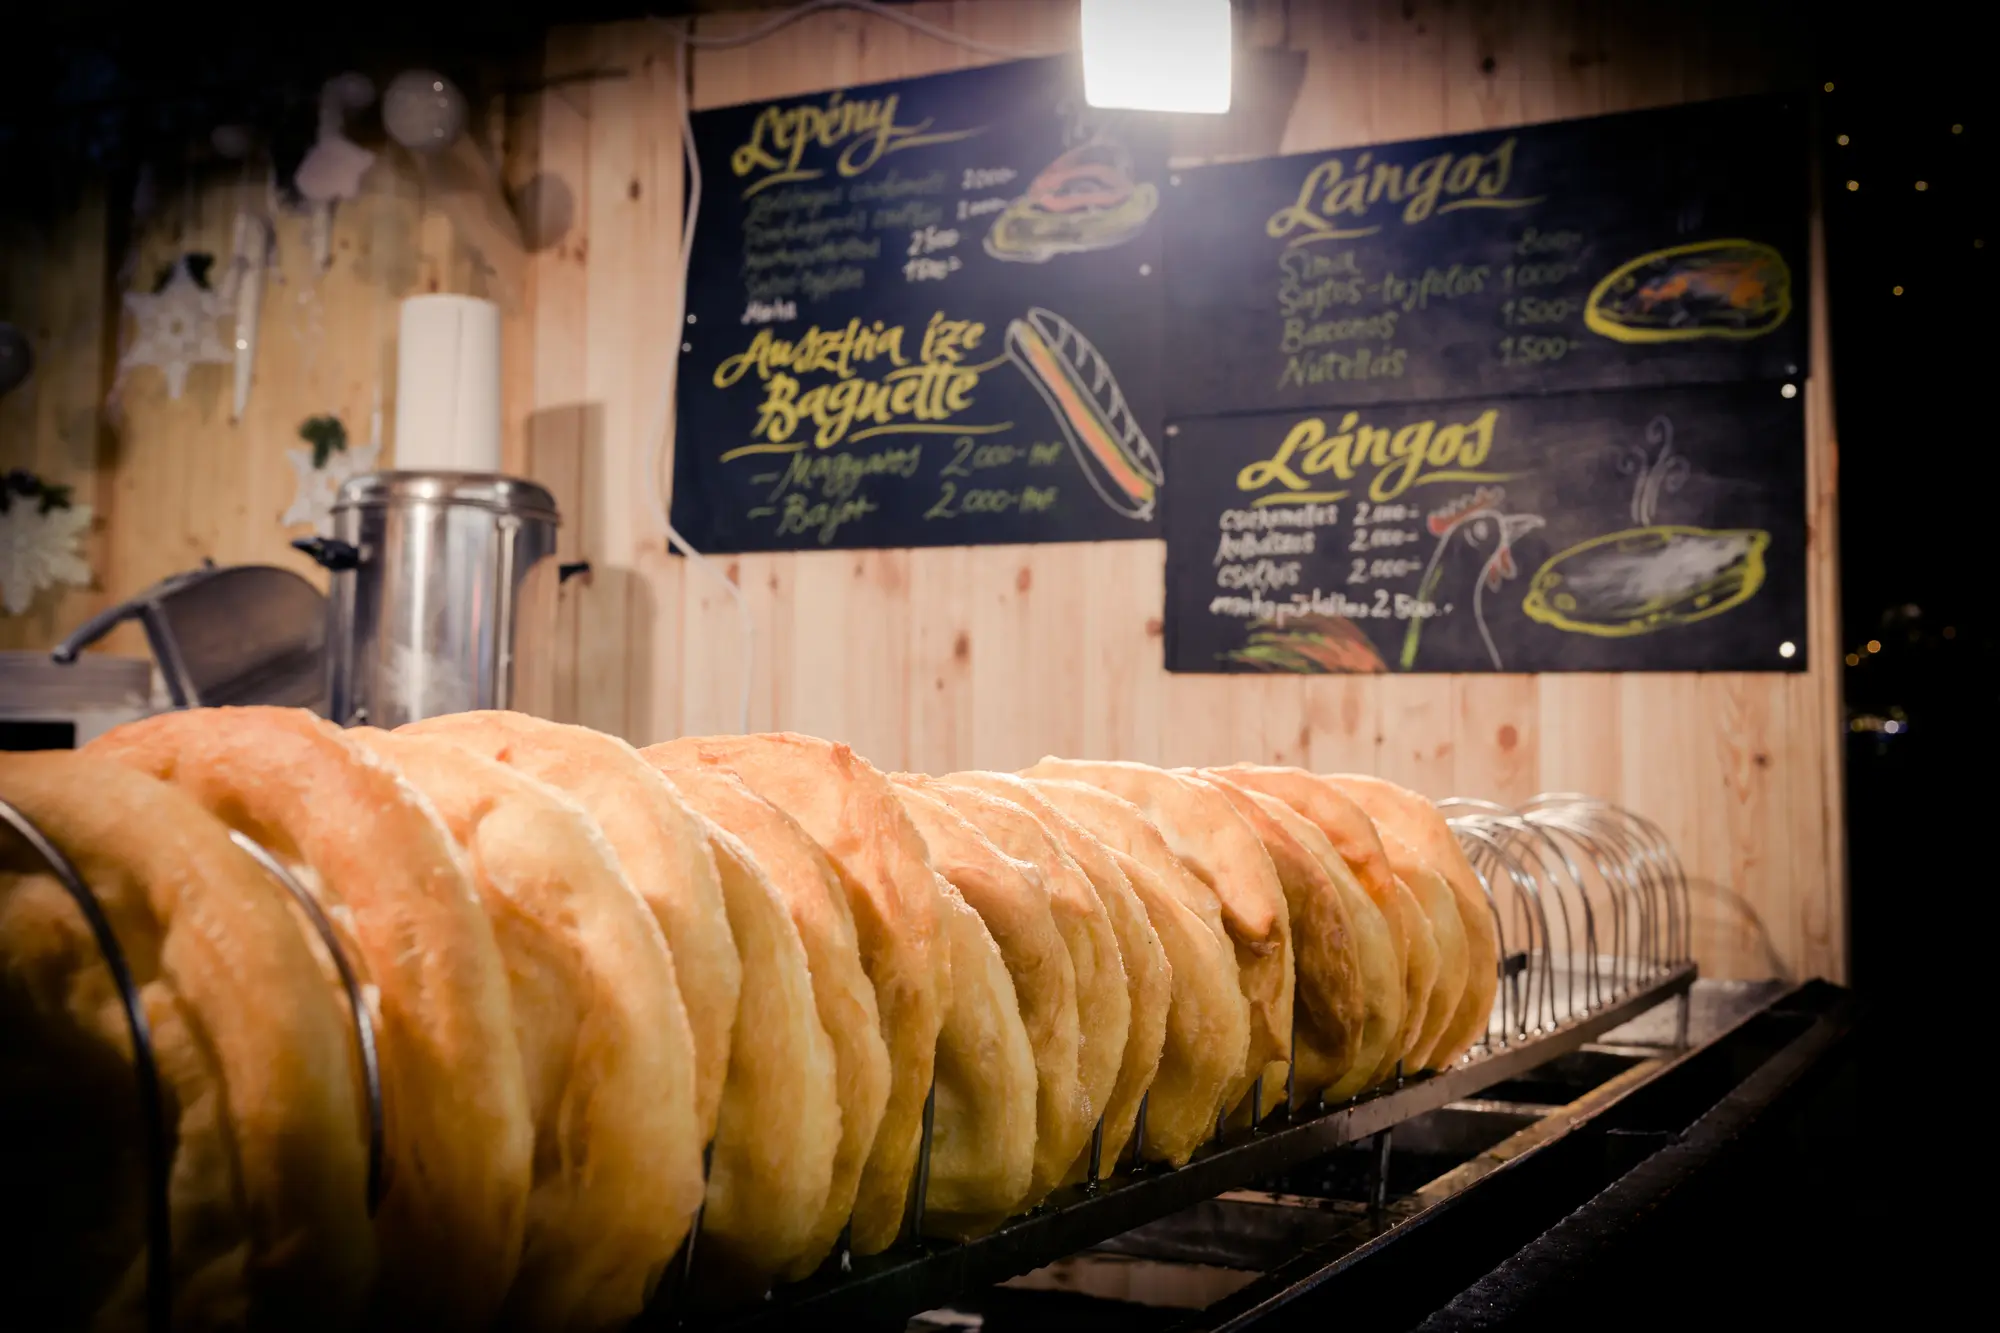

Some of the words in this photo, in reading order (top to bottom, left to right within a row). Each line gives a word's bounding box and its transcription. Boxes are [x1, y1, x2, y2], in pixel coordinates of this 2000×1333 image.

[731, 91, 934, 176] Lepény
[1266, 136, 1518, 237] Lángos
[713, 317, 909, 388] Ausztria
[751, 360, 980, 449] Baguette
[1236, 409, 1499, 502] Lángos
